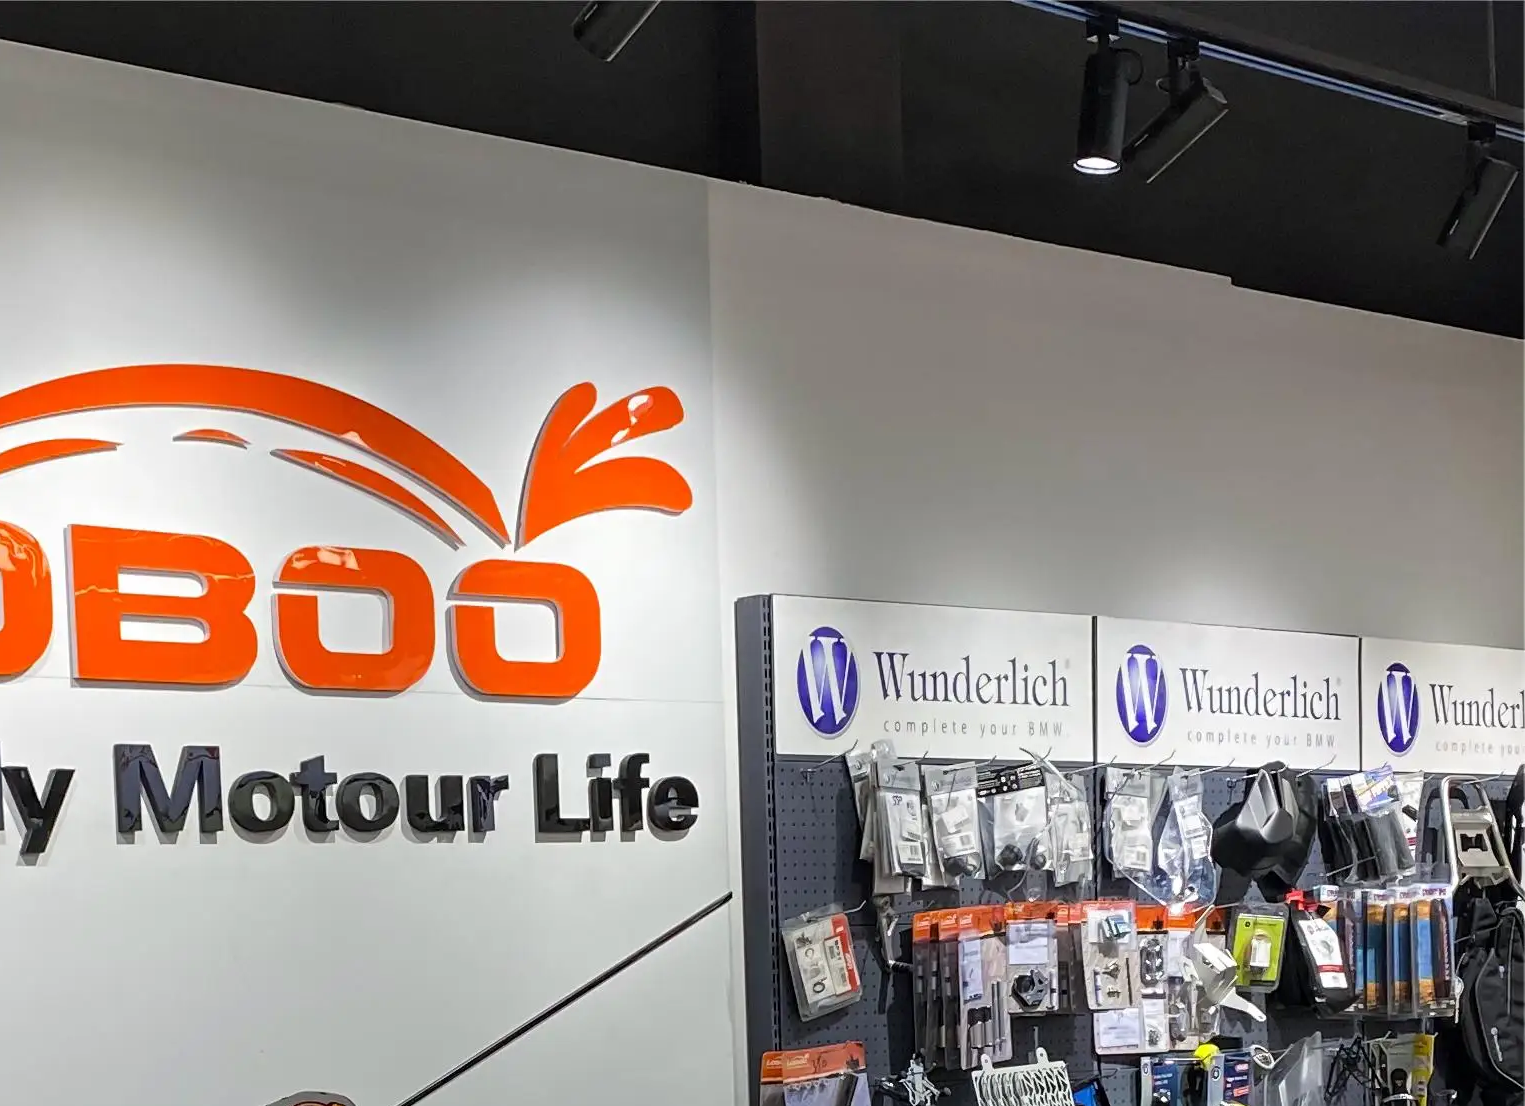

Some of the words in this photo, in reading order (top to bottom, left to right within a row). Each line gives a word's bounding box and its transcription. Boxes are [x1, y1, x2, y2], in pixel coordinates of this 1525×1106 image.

[873, 650, 1071, 707] Wunderlich
[1179, 667, 1342, 721] Wunderlich
[883, 717, 968, 737] complete
[979, 720, 1017, 739] your
[1187, 728, 1257, 746] complete
[1265, 732, 1299, 748] your
[1435, 740, 1494, 756] complete
[1500, 744, 1525, 758] you
[112, 744, 509, 838] Motour
[531, 751, 699, 840] Life
